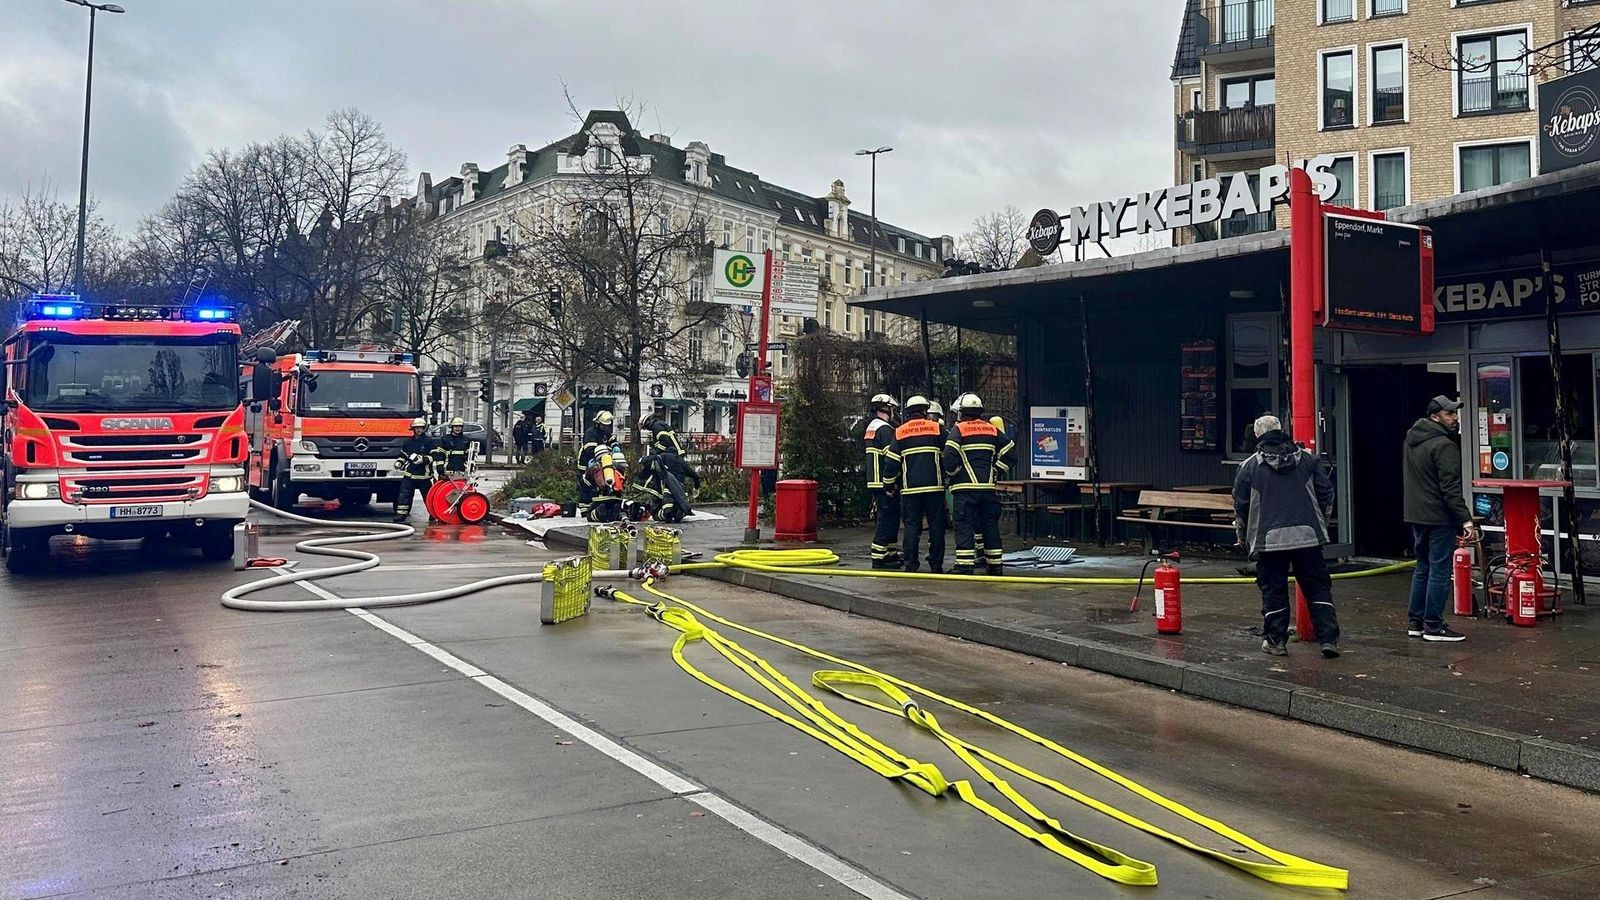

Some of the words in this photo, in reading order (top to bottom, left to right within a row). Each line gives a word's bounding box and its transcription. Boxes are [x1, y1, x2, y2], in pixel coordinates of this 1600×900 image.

[1549, 105, 1600, 137] Kebap's
[1578, 134, 1594, 151] CULTURE
[1070, 197, 1131, 247] MY
[1136, 155, 1341, 235] KEBAP'S
[1334, 220, 1366, 233] Eppendorf,
[1366, 225, 1384, 235] Markt
[732, 262, 747, 281] H
[1433, 274, 1566, 313] KEBAP'S
[1579, 280, 1600, 293] STR
[101, 417, 173, 430] SCANIA
[136, 507, 158, 515] 8773
